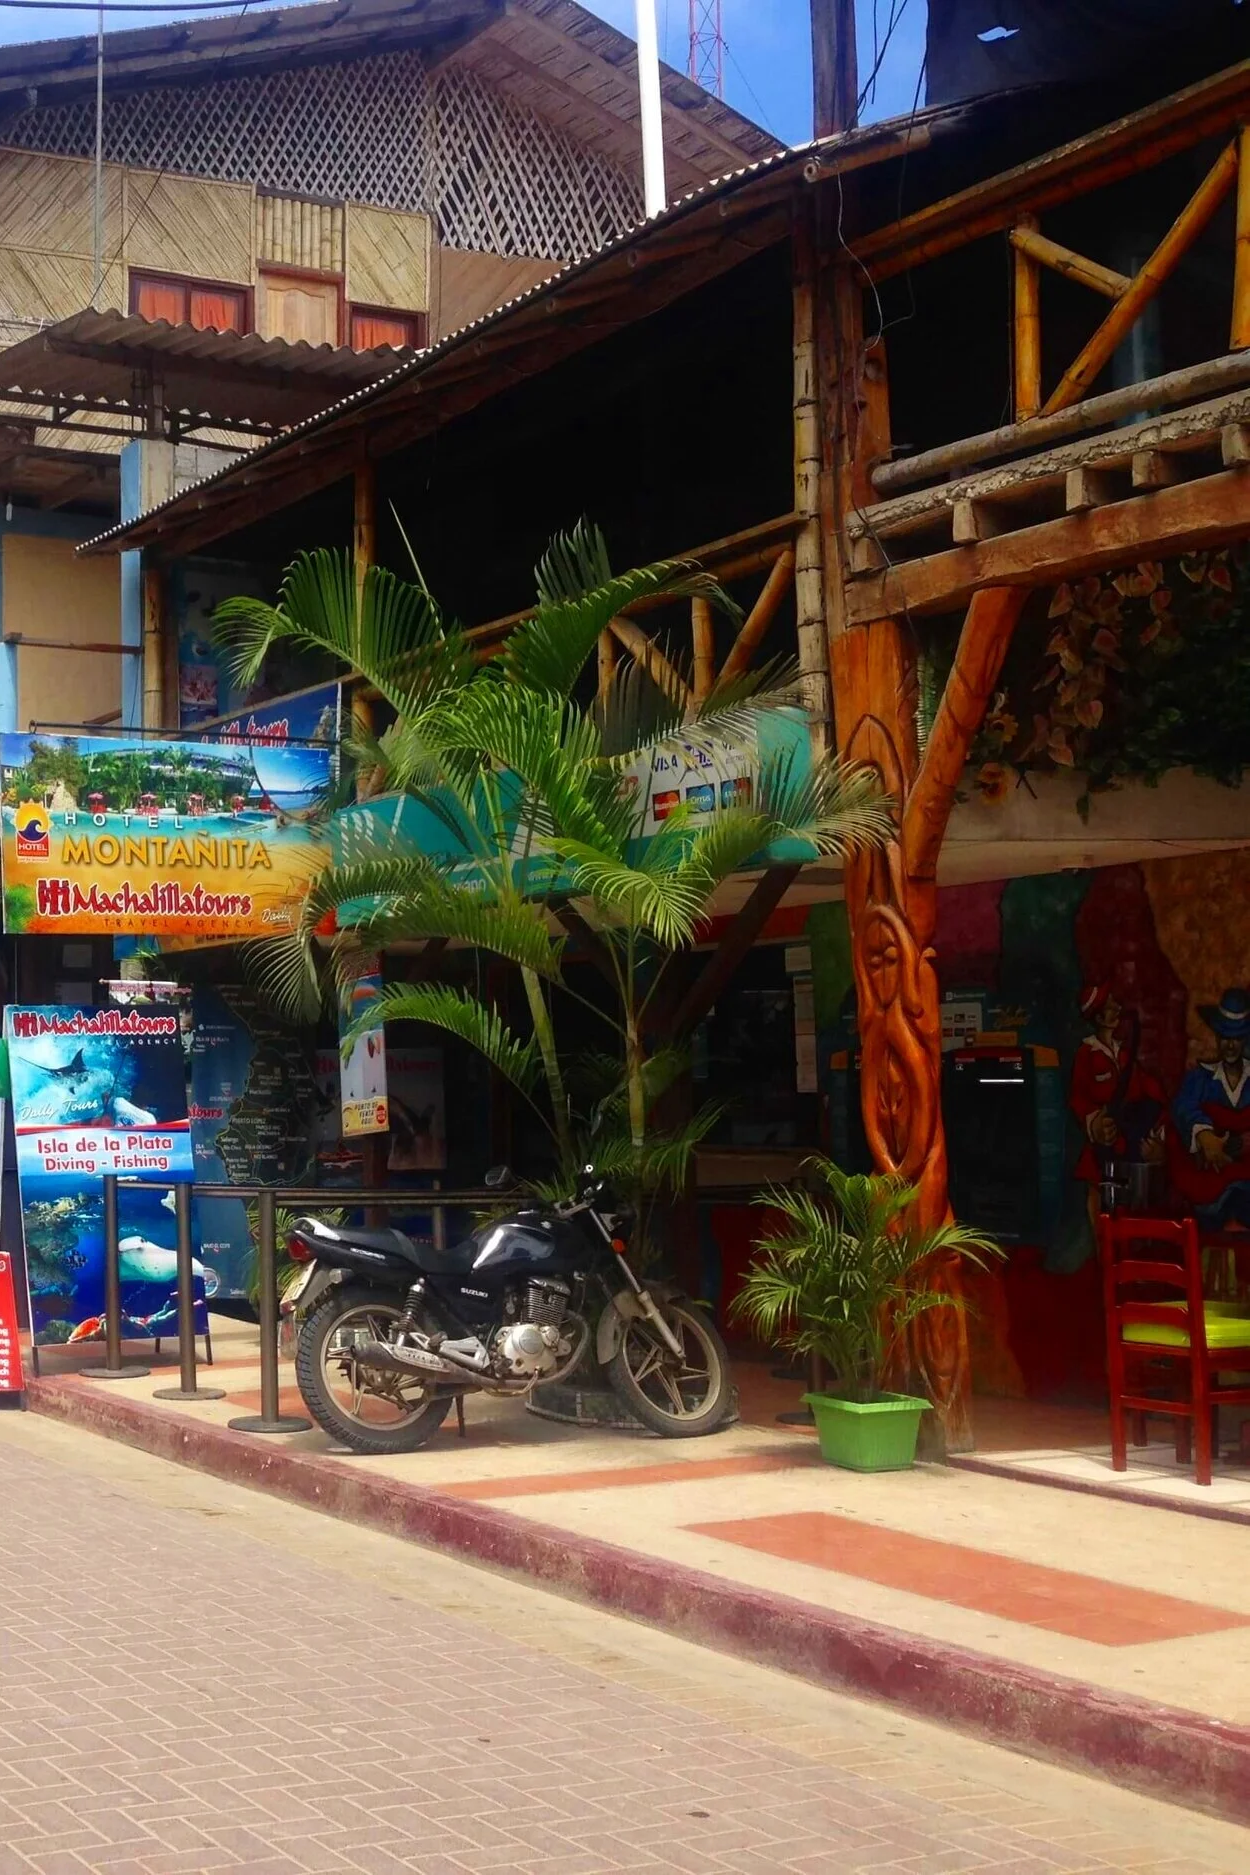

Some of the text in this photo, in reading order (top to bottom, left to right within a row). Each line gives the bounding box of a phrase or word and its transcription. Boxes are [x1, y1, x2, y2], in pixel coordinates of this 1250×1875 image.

[64, 812, 183, 830] HOTEL
[18, 843, 48, 851] HOTEL
[62, 831, 273, 869] MONTAÑITA
[104, 918, 254, 928] TRAVEL AGENCY
[130, 1038, 177, 1046] AGENCY
[21, 1099, 99, 1120] Daily Tours
[38, 1135, 172, 1154] Isla de la Plata
[45, 1157, 95, 1173] Diving
[114, 1154, 168, 1170] Fishing
[460, 1287, 489, 1298] SUZUKI
